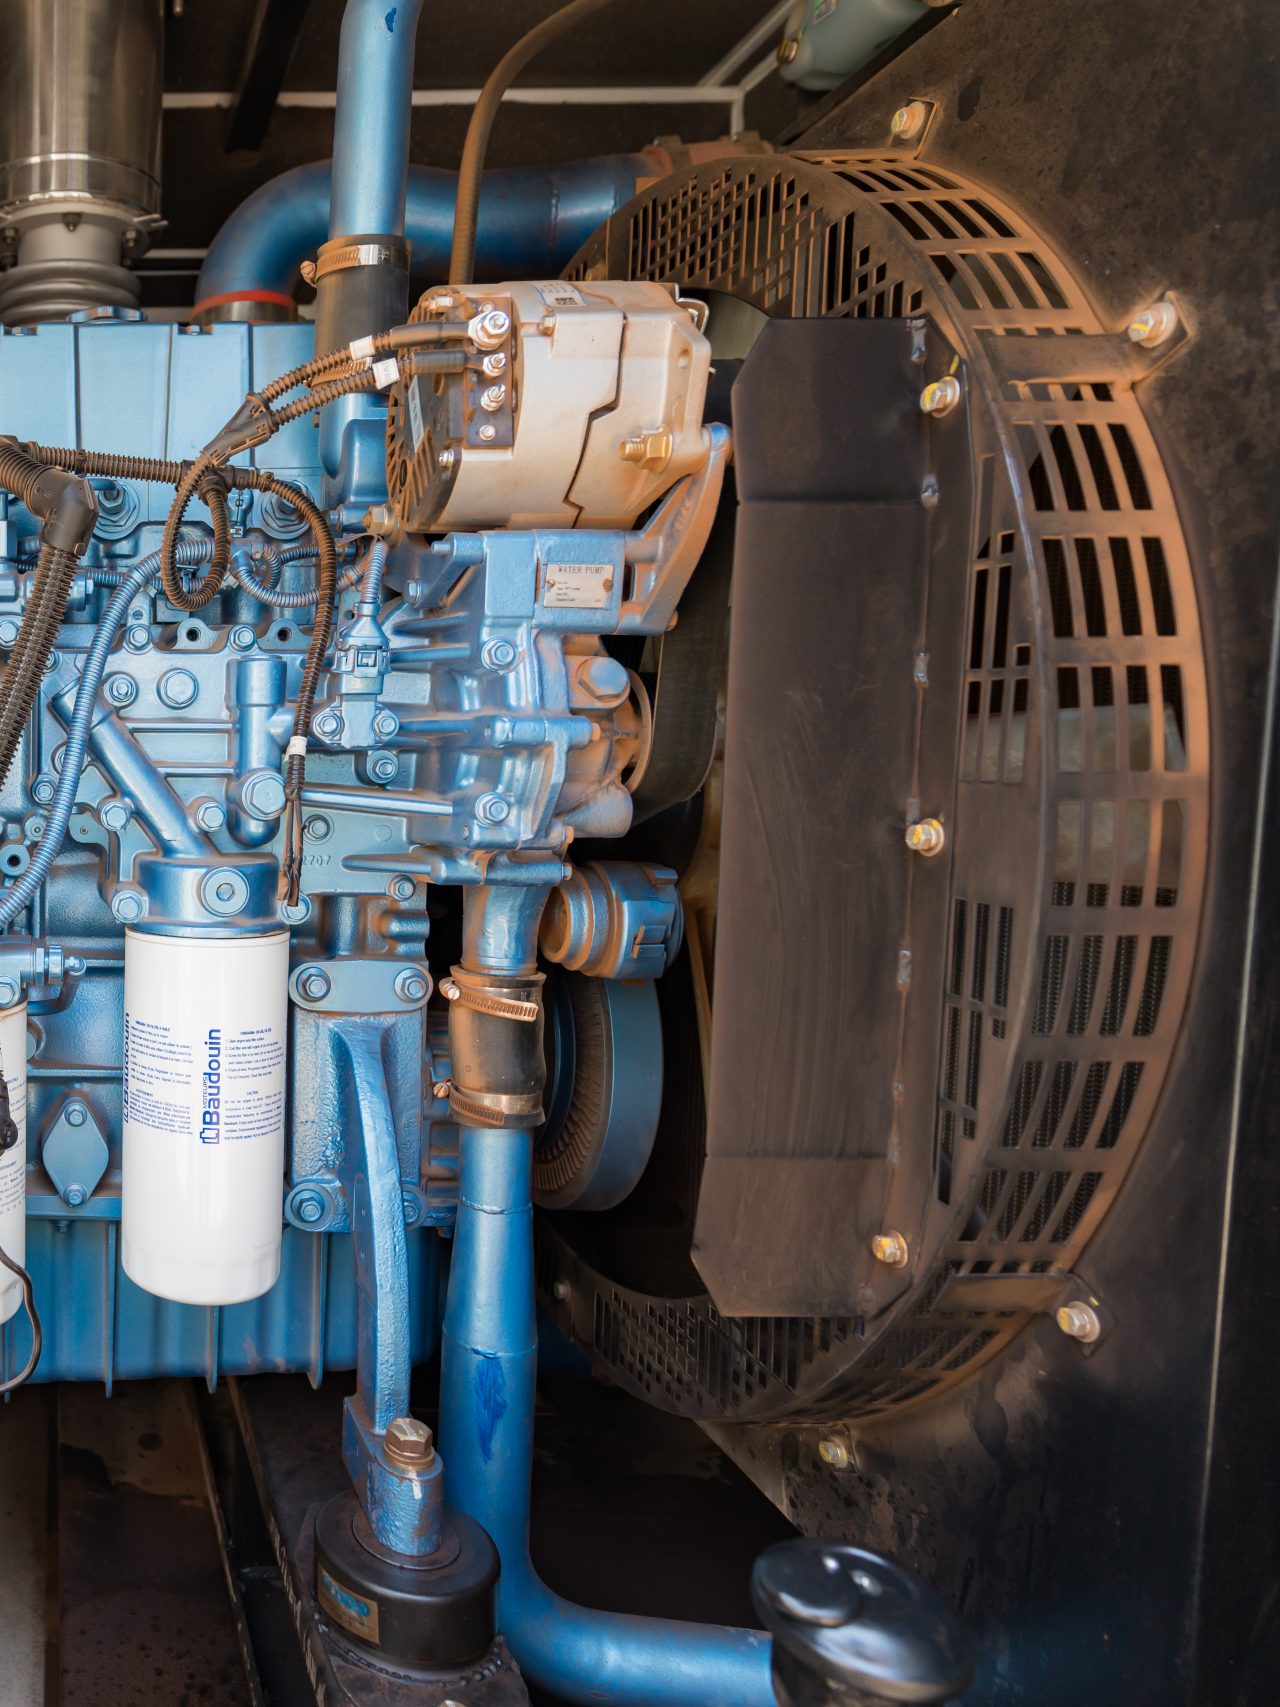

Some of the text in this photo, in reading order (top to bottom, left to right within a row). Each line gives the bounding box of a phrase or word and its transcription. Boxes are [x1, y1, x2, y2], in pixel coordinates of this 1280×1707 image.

[558, 566, 605, 575] WATER PUMP
[202, 1028, 221, 1125] Baudouin
